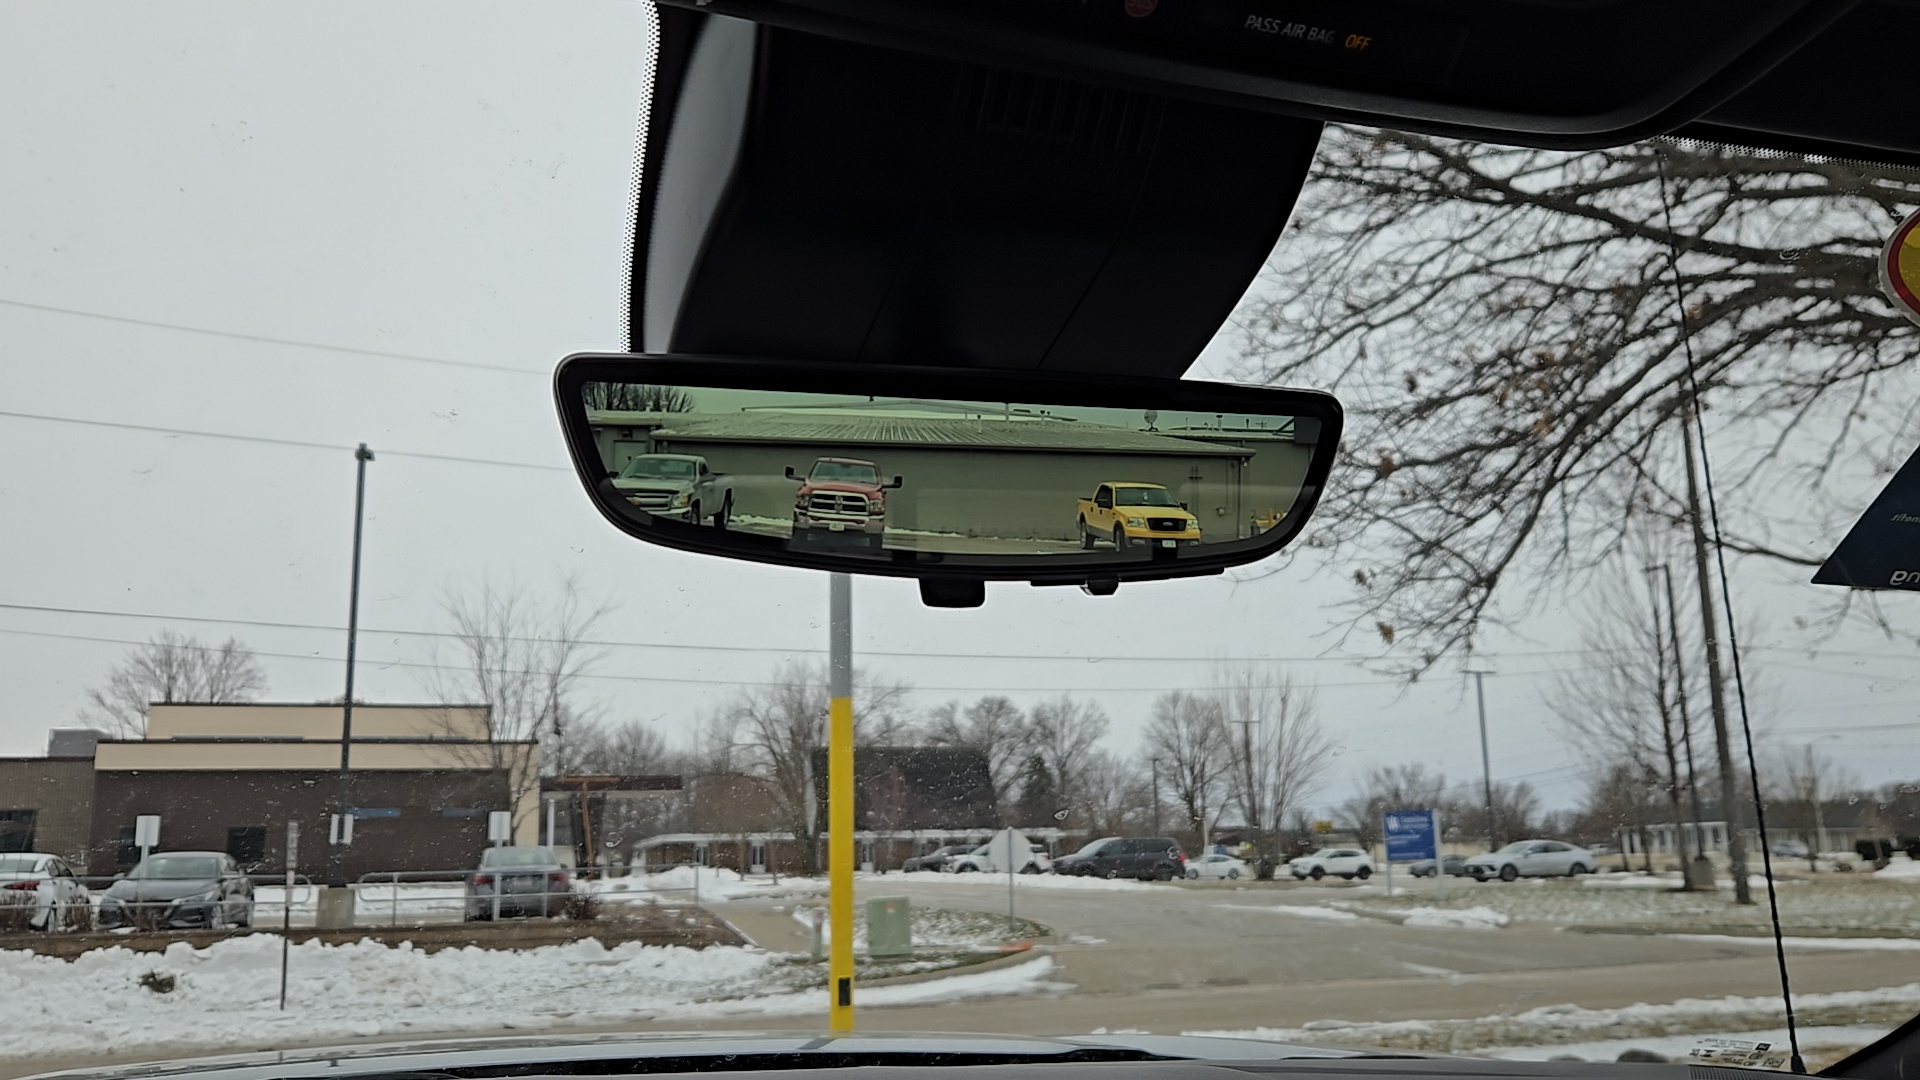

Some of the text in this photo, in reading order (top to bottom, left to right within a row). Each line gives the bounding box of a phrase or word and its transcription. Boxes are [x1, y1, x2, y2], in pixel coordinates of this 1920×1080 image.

[1244, 14, 1373, 51] PASS AIR BAG OFF
